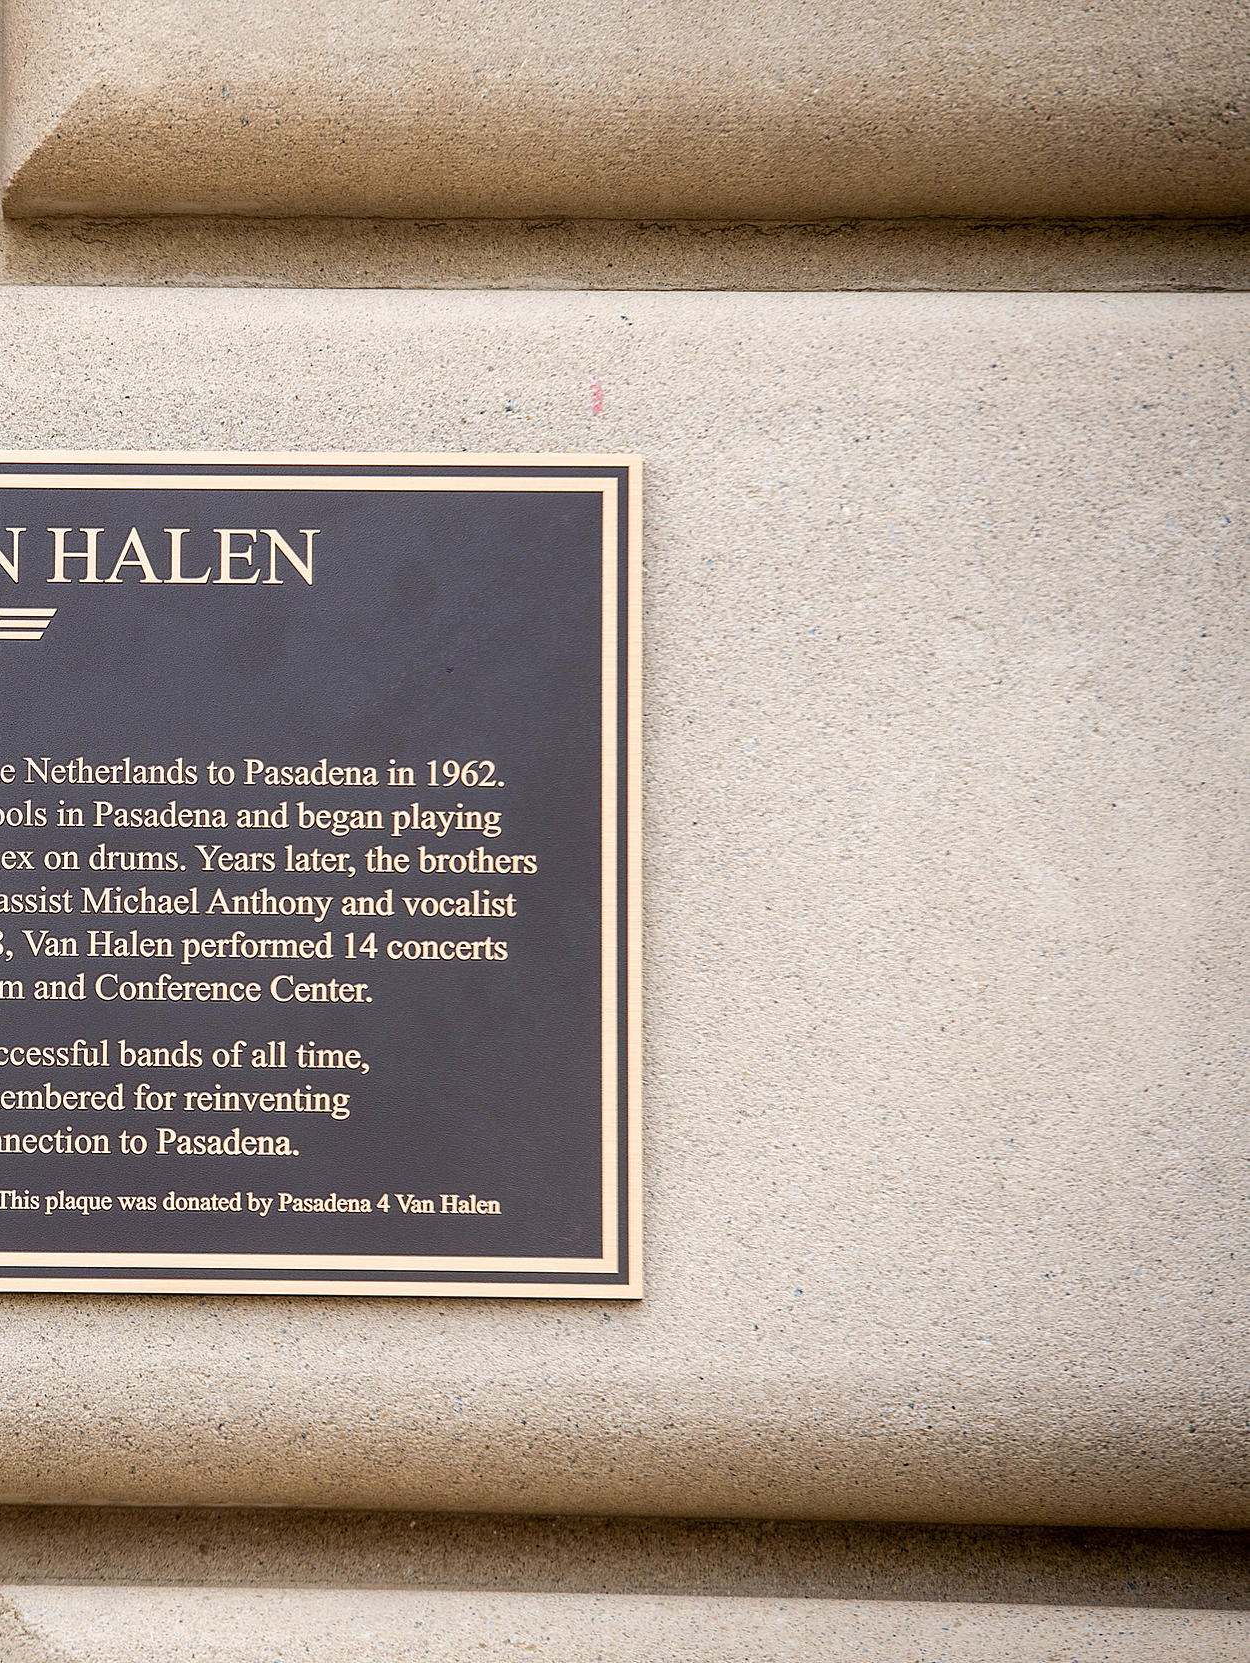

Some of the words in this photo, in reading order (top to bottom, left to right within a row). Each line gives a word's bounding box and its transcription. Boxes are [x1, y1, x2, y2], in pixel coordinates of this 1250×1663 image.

[46, 526, 321, 586] HALEN
[22, 756, 198, 785] Netherlands
[206, 760, 235, 785] to
[243, 758, 380, 786] Pasadena
[386, 758, 417, 786] in
[426, 759, 505, 788] 1962.
[56, 799, 86, 827] in
[92, 800, 229, 828] Pasadena
[236, 801, 290, 829] and
[296, 801, 385, 837] began
[390, 802, 503, 838] playing
[43, 851, 81, 870] on
[88, 843, 186, 871] drums.
[194, 844, 276, 872] Years
[284, 844, 356, 878] later,
[364, 845, 410, 873] the
[416, 845, 538, 874] brothers
[80, 886, 200, 915] Michael
[204, 887, 334, 923] Anthony
[341, 888, 396, 917] and
[401, 889, 518, 918] vocalist
[21, 929, 80, 957] Van
[86, 929, 175, 958] Halen
[180, 930, 335, 965] performed
[344, 932, 379, 959] 14
[386, 936, 509, 961] concerts
[33, 972, 87, 1000] and
[95, 973, 262, 1002] Conference
[270, 974, 373, 1003] Center.
[117, 1039, 203, 1068] bands
[212, 1040, 248, 1068] of
[251, 1040, 288, 1068] all
[295, 1040, 370, 1075] time,
[133, 1083, 177, 1111] for
[183, 1083, 351, 1120] reinventing
[118, 1129, 148, 1155] to
[155, 1127, 300, 1157] Pasadena.
[44, 1189, 113, 1216] plaque
[116, 1196, 158, 1211] was
[162, 1190, 243, 1212] donated
[246, 1191, 274, 1217] by
[277, 1192, 373, 1213] Pasadena
[376, 1193, 391, 1213] 4
[393, 1193, 436, 1214] Van
[439, 1194, 503, 1215] Halen
